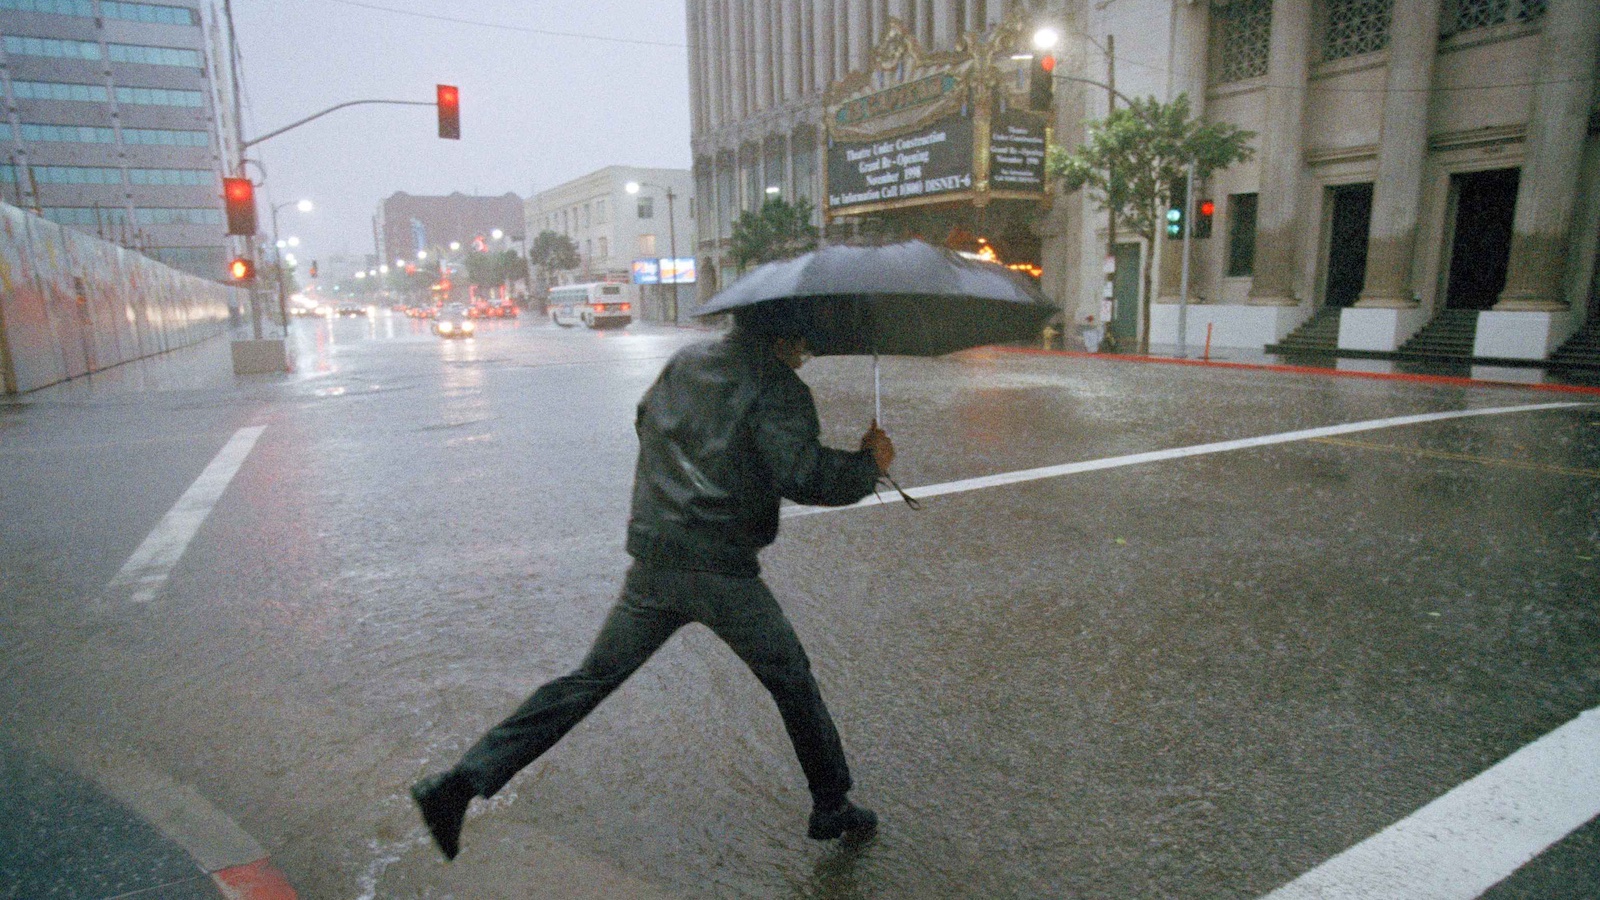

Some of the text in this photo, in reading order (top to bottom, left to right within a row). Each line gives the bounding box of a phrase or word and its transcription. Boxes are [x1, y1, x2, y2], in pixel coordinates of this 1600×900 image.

[873, 141, 894, 155] Under
[895, 130, 946, 151] Construction
[859, 150, 929, 173] Grand Re-Opening
[866, 171, 899, 186] November
[841, 190, 880, 204] Information
[881, 185, 898, 198] Call
